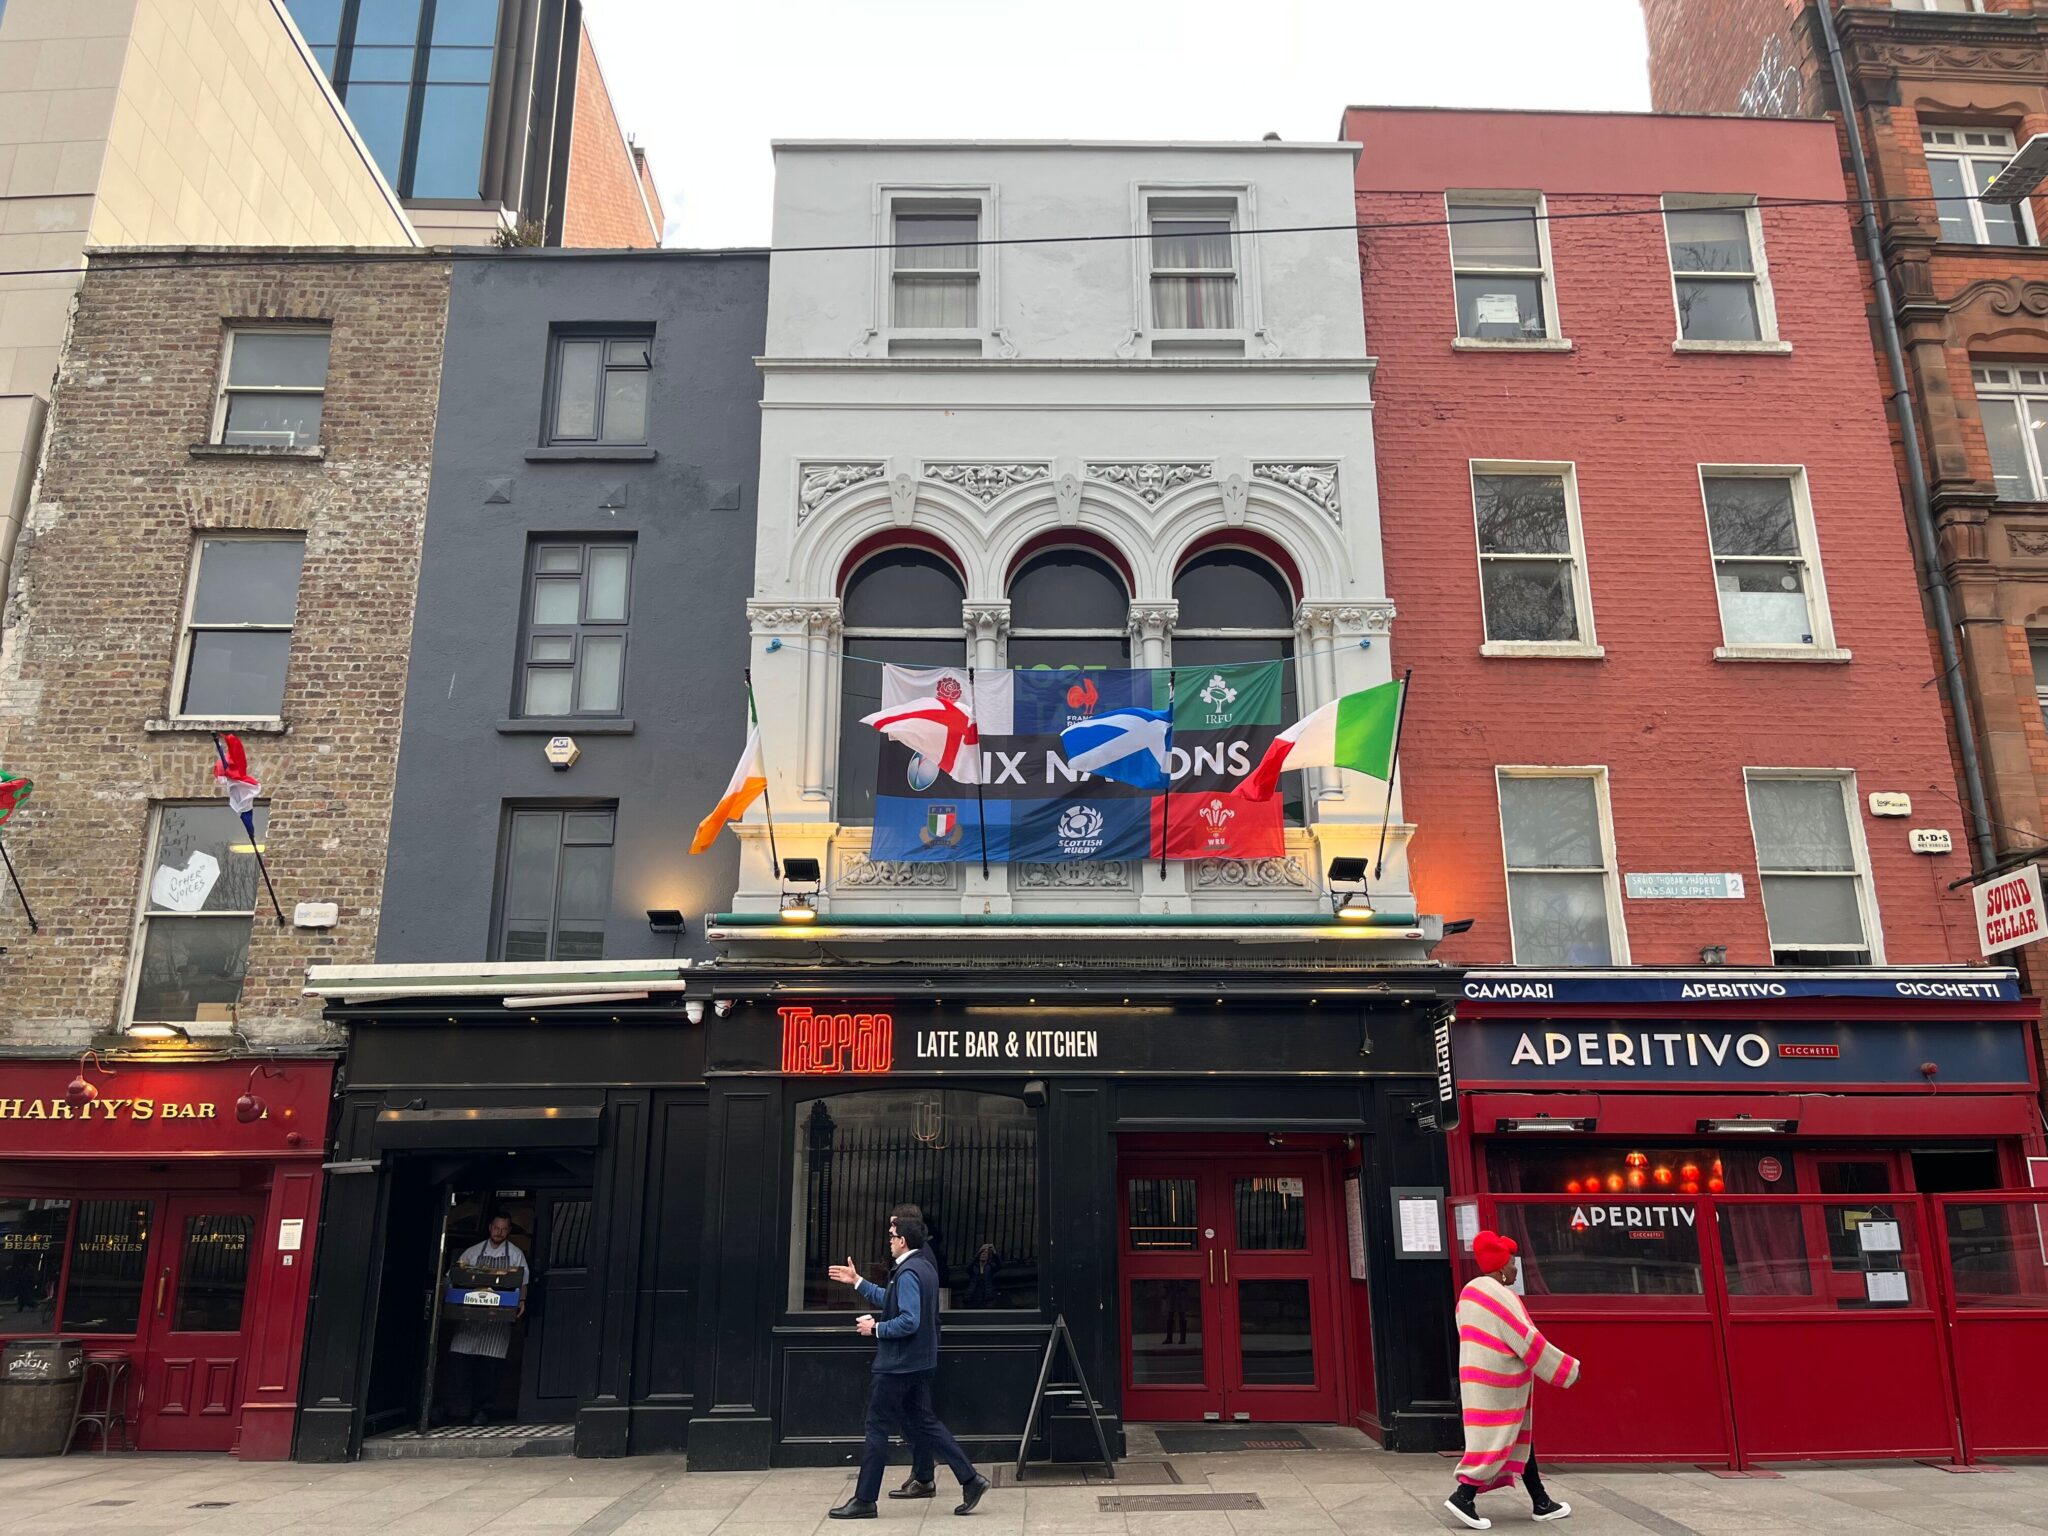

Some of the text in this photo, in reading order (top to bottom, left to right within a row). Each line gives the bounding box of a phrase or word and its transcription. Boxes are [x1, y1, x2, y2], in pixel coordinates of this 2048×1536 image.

[1205, 713, 1232, 724] IRFU
[981, 740, 1251, 784] IX NONS
[1057, 839, 1103, 847] SCOTTISH
[1063, 846, 1097, 854] RUGBY
[1655, 876, 1684, 885] THOBAR
[1730, 879, 1740, 892] 2
[168, 879, 206, 903] VOICES
[1639, 886, 1716, 896] NASSAU STREET
[1986, 878, 2032, 918] SOUND
[1986, 908, 2039, 945] CELLAR
[1464, 983, 1554, 999] CAMPARI
[1681, 983, 1786, 998] APERITIVO
[1895, 982, 2001, 999] CICCHETTI
[777, 1006, 893, 1073] TAPPED
[916, 1030, 1098, 1058] LATE BAR & KITCHEN
[1510, 1032, 1770, 1068] APERITIVO
[1784, 1046, 1835, 1056] CICCHETTI
[160, 1102, 216, 1119] BAR
[1570, 1206, 1720, 1227] APERITIV
[4, 1233, 53, 1242] CRAFT
[94, 1234, 130, 1243] IRISH
[3, 1242, 51, 1250] BEERS
[80, 1243, 143, 1252] WHISKIES
